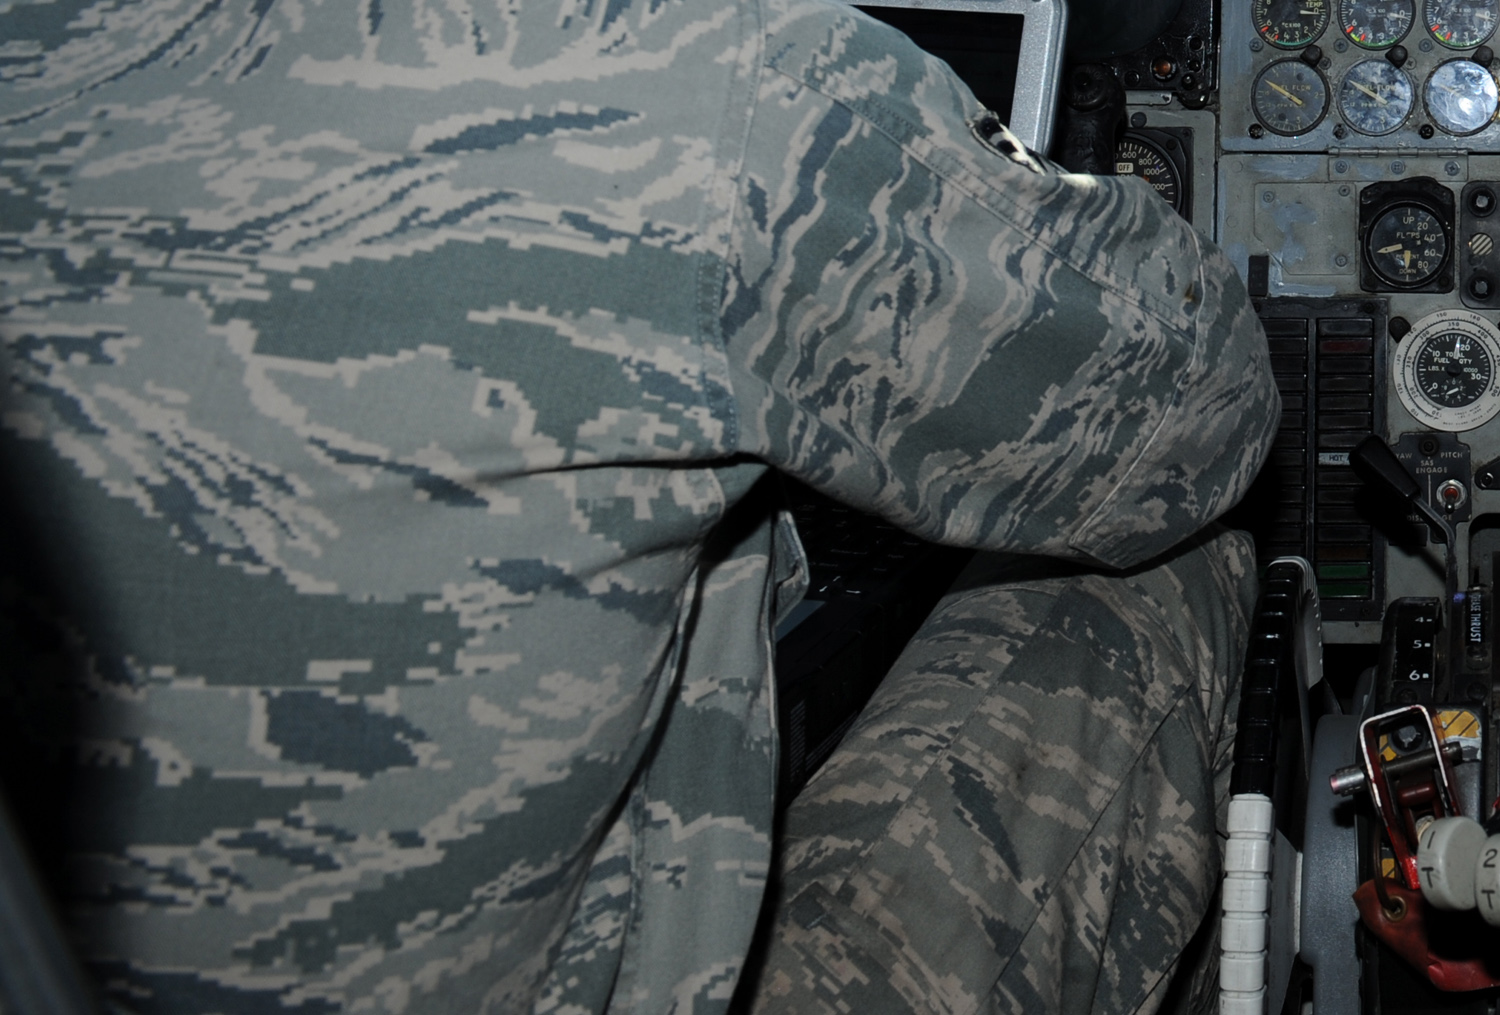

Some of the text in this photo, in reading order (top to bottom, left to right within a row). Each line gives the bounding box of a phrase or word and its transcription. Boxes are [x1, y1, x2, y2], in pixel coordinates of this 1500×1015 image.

[1470, 614, 1481, 642] THRUST
[1413, 640, 1422, 648] 5
[1409, 670, 1420, 680] 6
[1483, 849, 1497, 867] 2
[1421, 867, 1434, 888] T
[1481, 890, 1495, 909] T
